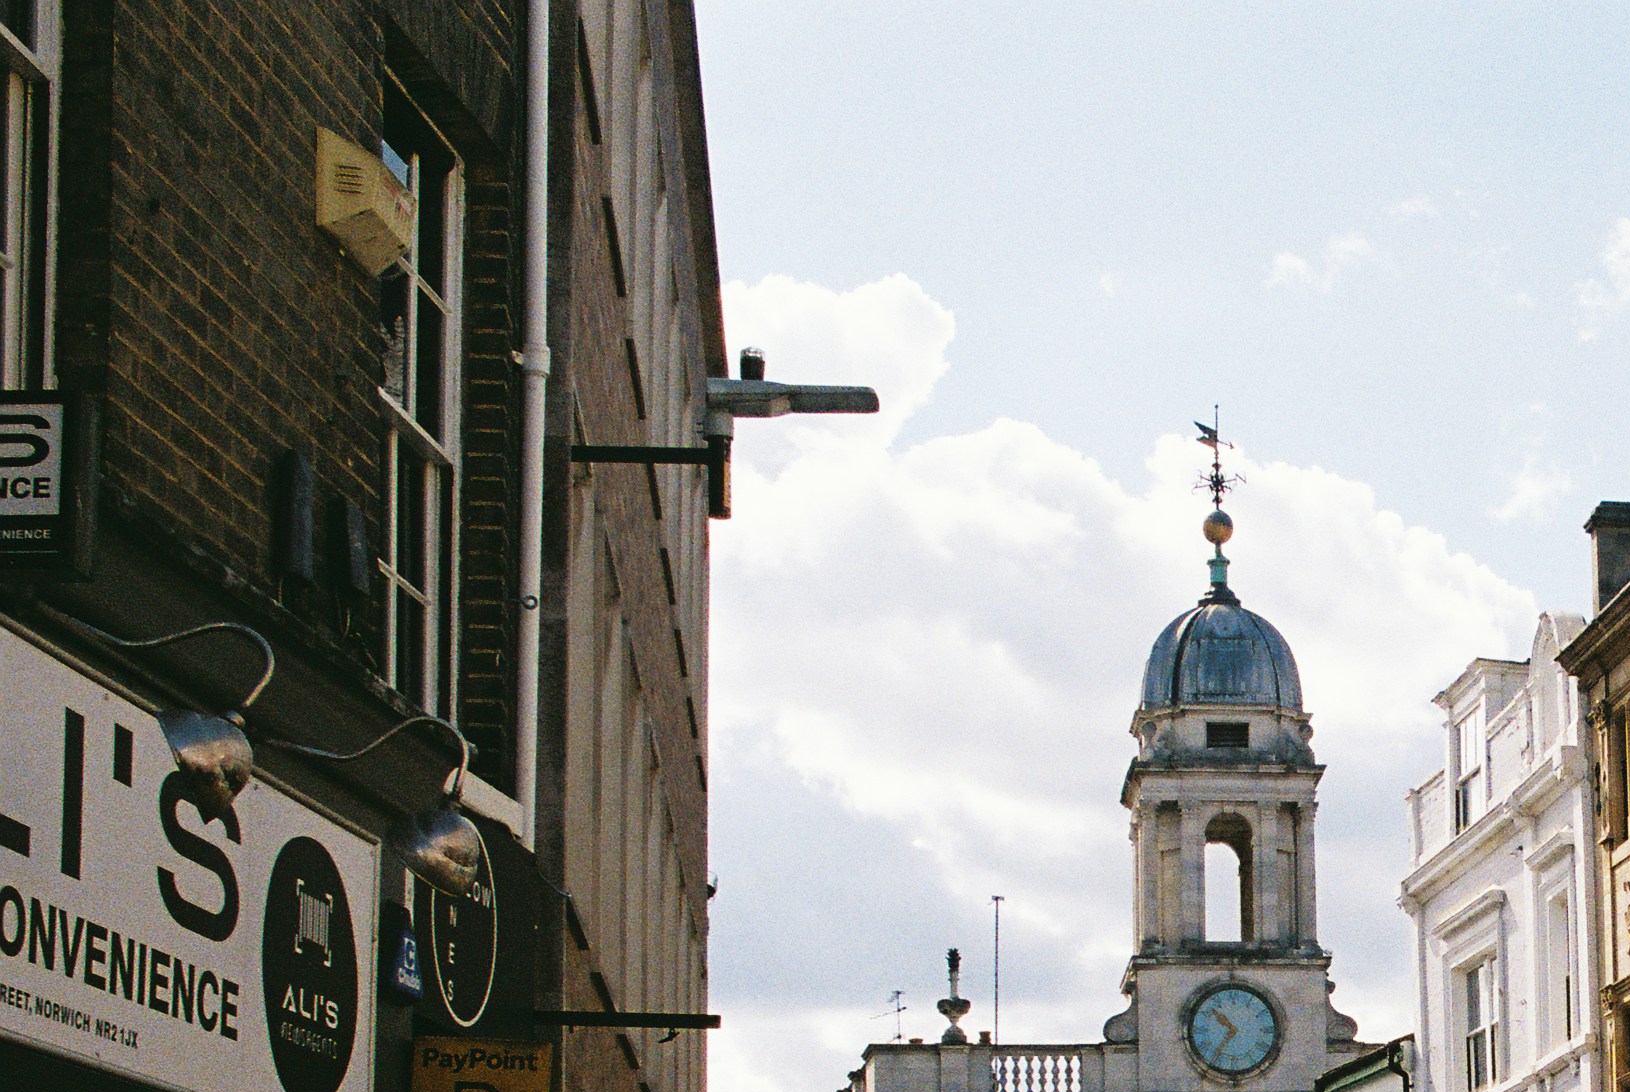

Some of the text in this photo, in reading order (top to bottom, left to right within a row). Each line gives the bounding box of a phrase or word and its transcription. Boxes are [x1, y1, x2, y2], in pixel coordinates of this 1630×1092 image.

[0, 529, 51, 540] NIENCE
[35, 996, 91, 1033] NORWICH
[95, 1020, 119, 1042] NR2
[120, 1028, 139, 1049] 1JX
[281, 983, 340, 1030] ALI'S
[422, 1047, 539, 1073] PayPoint
